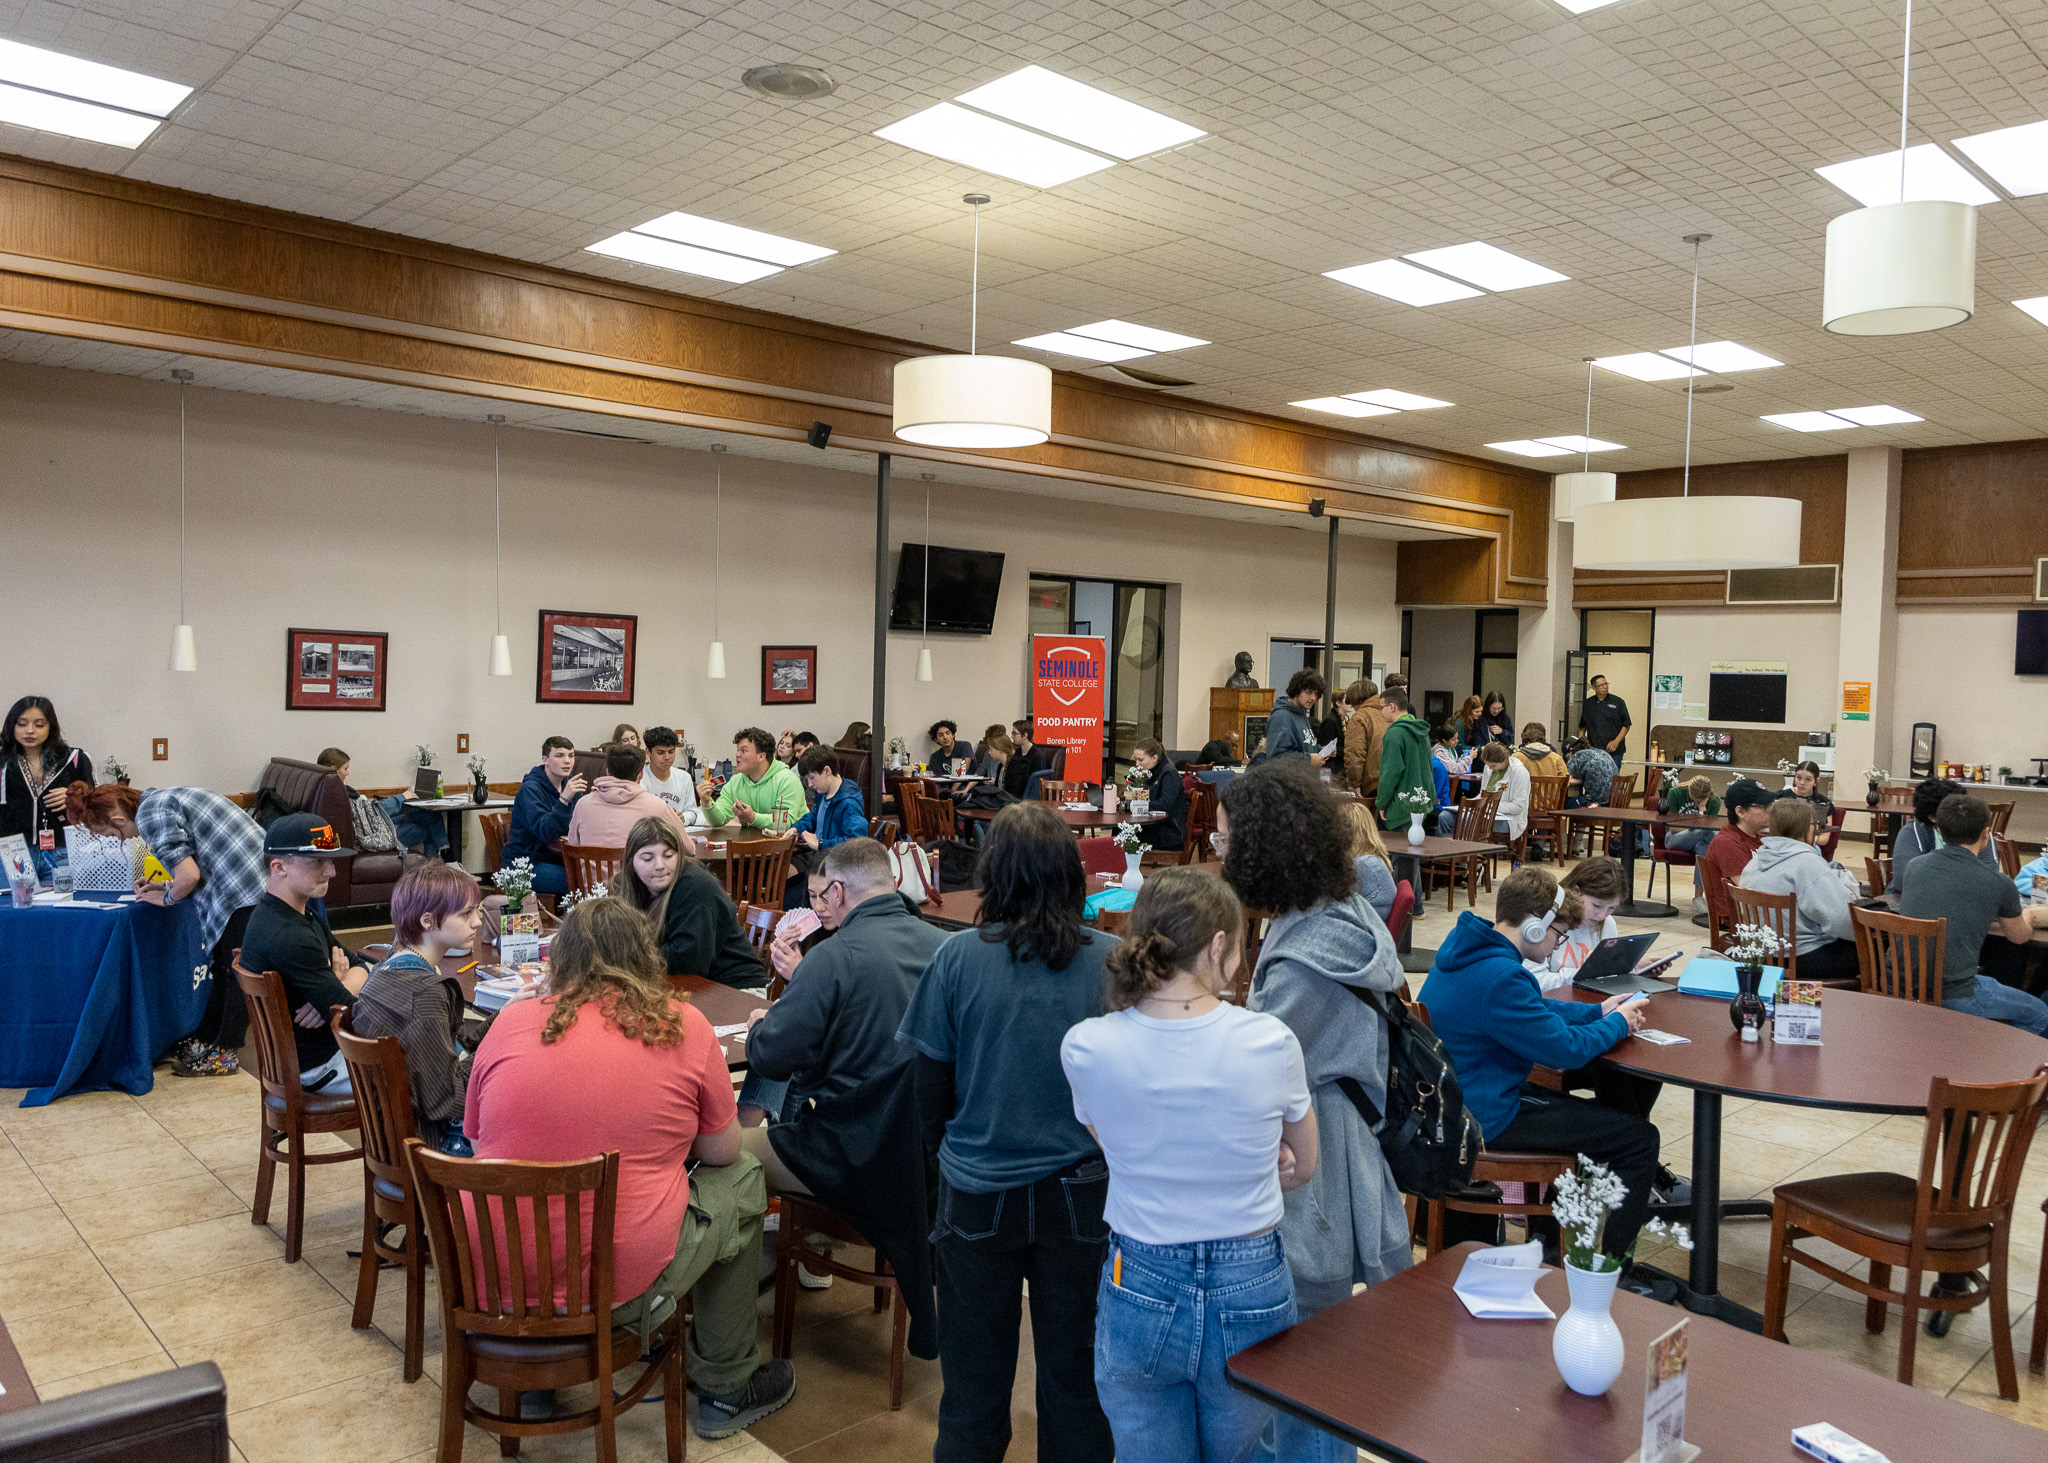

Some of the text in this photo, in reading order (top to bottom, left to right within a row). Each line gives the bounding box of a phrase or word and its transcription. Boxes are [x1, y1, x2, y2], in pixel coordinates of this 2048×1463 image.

[1038, 660, 1099, 679] SEMINOLE
[1038, 679, 1098, 688] STATE COLLEGE
[1037, 717, 1098, 727] FOOD PANTRY
[1046, 737, 1087, 746] Boren Library
[1071, 746, 1082, 754] 101
[712, 1400, 739, 1413] MERRELL
